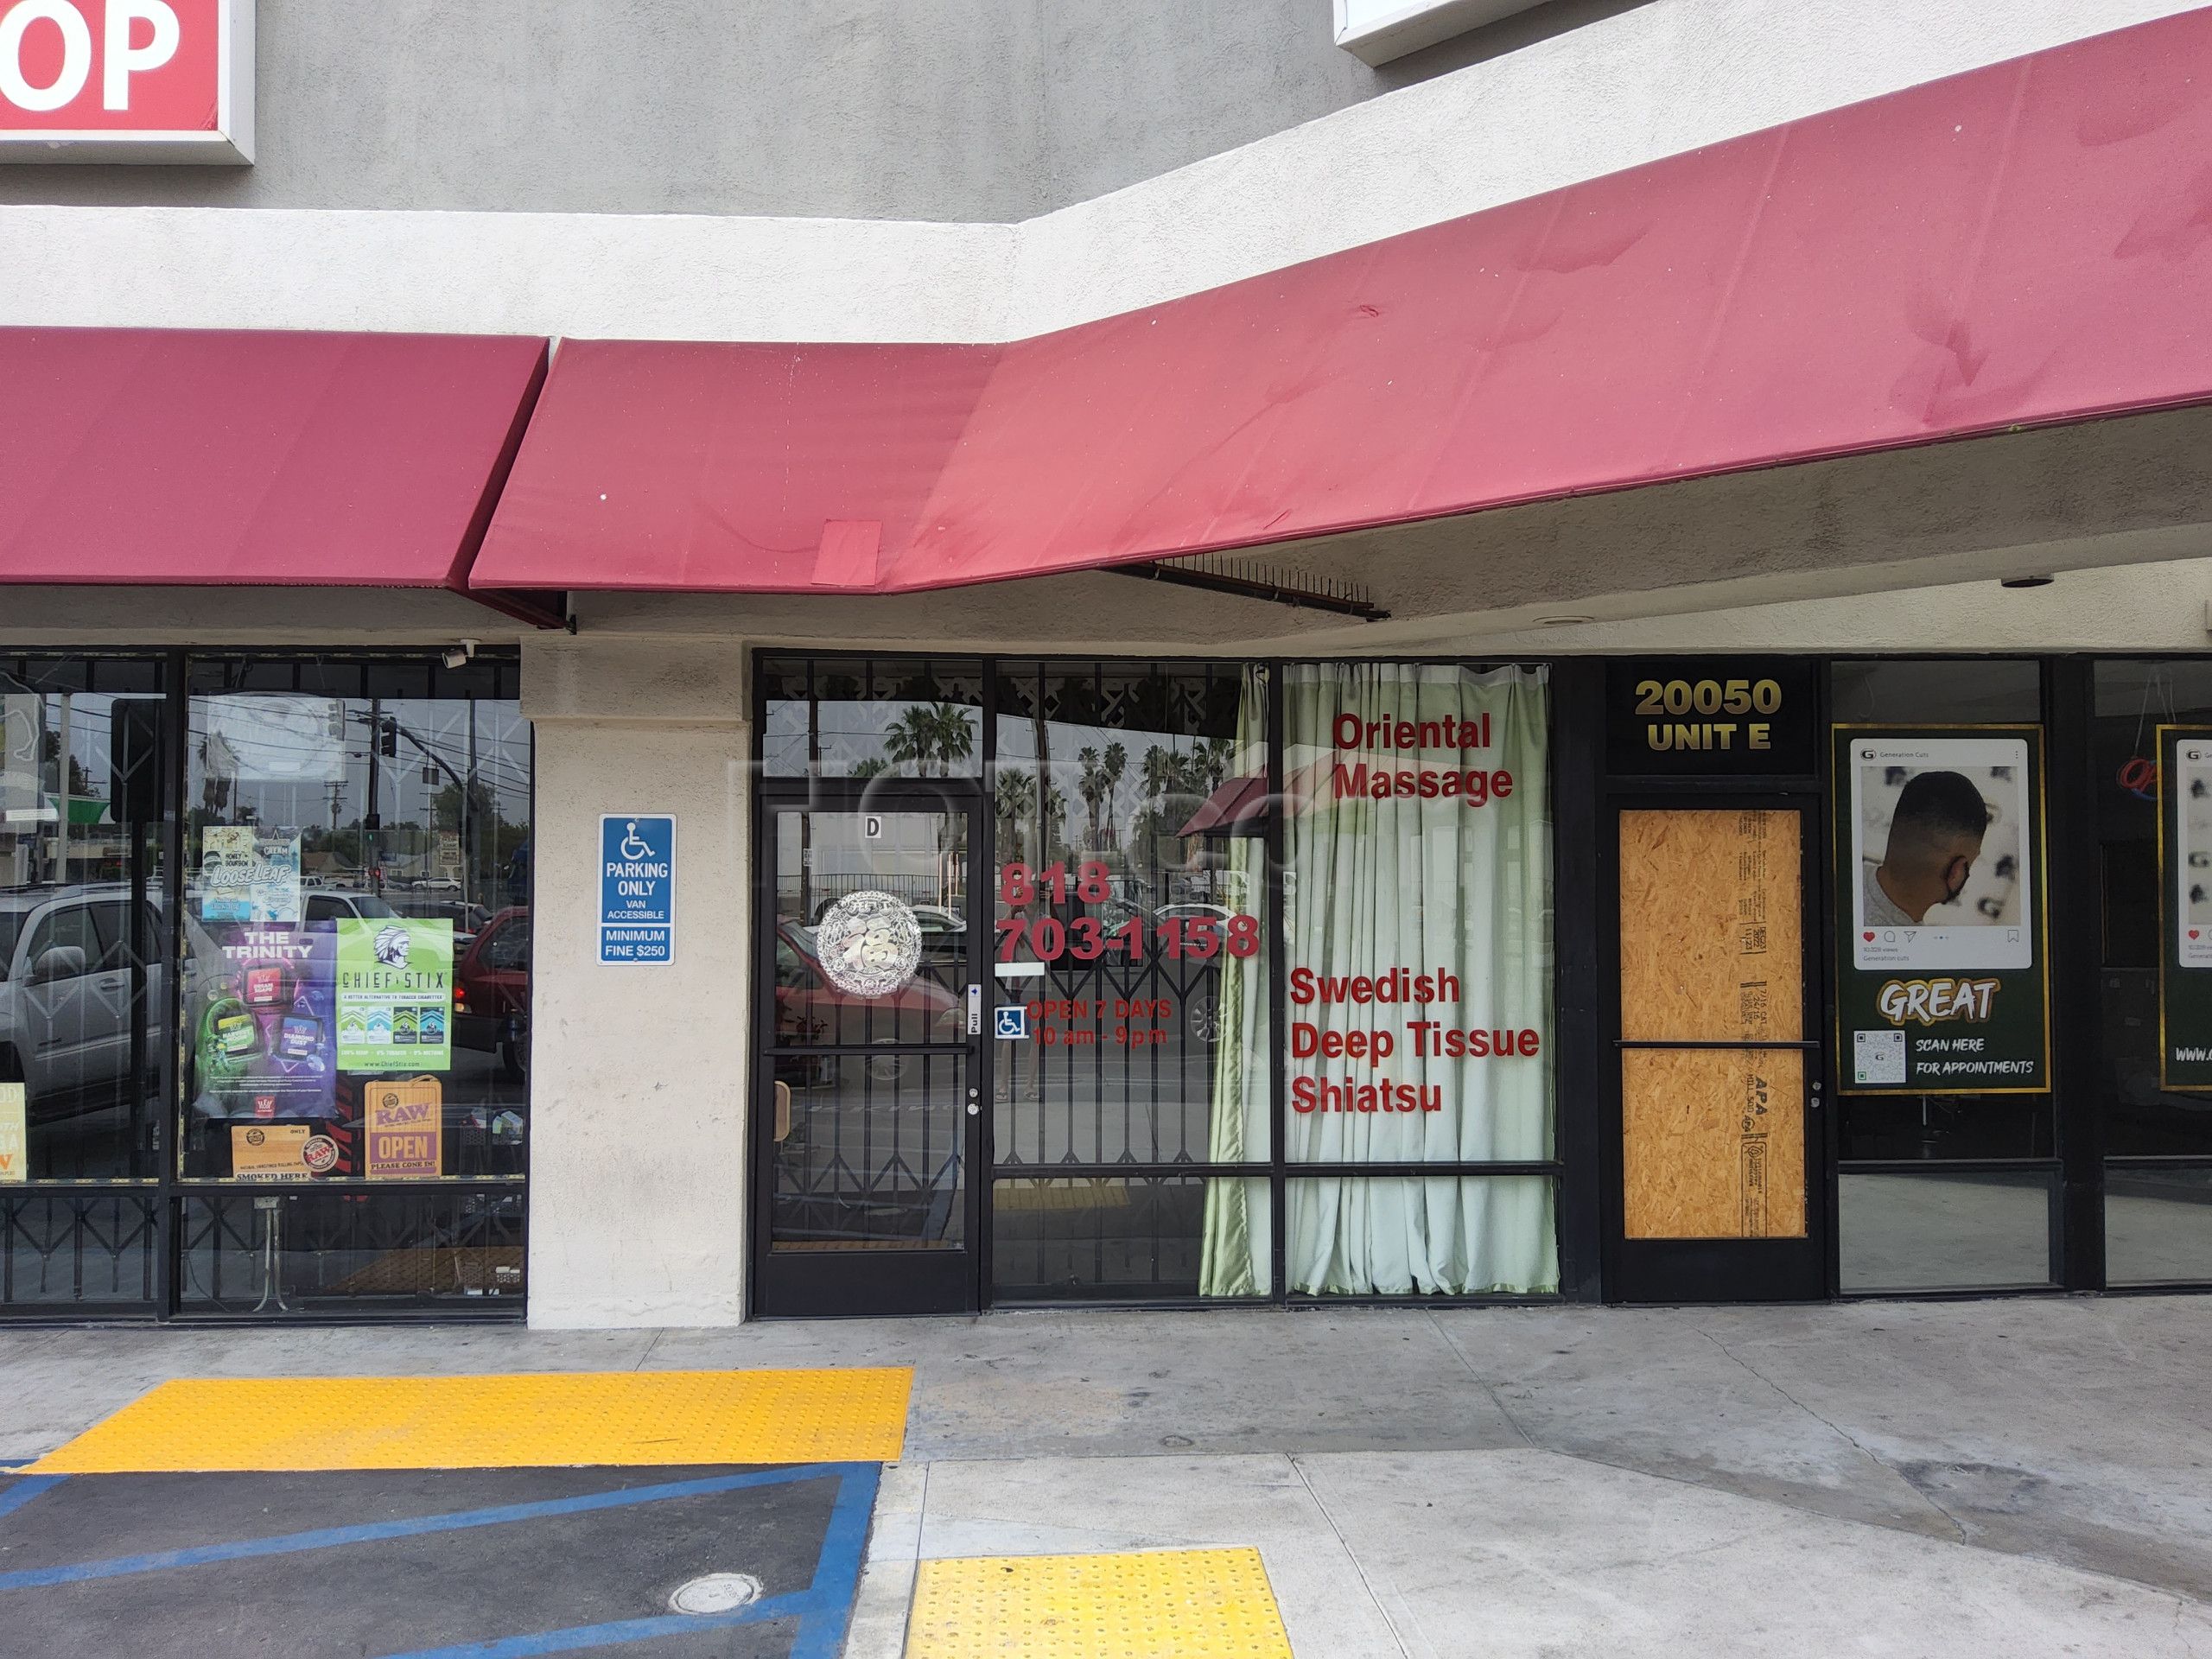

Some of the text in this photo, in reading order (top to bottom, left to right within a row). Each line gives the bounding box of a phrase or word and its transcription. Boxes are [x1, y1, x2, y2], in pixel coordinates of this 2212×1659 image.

[0, 0, 180, 111] OP
[1635, 679, 1782, 715] 20050
[1332, 712, 1490, 750] Oriental
[1648, 723, 1770, 751] UNIT E
[1334, 763, 1513, 807] Massage
[867, 817, 879, 836] D
[607, 862, 668, 878] PARKING
[618, 880, 656, 896] ONLY
[1001, 861, 1110, 906] 818
[607, 911, 664, 919] ACCESSIBLE
[245, 931, 289, 944] THE
[606, 930, 665, 941] MINIMUM
[996, 914, 1259, 963] 703-1158
[222, 946, 313, 958] TRINITY
[606, 944, 665, 957] FINE $250
[404, 972, 443, 988] STIX
[1290, 967, 1459, 1004] Swedish
[1027, 999, 1172, 1020] OPEN 7 DAYS
[1880, 982, 1996, 1021] GREAT
[1033, 1027, 1057, 1046] 10
[1063, 1031, 1095, 1046] am
[1292, 1021, 1539, 1067] Deep Tissue
[1916, 1038, 1985, 1052] SCAN HERE
[1916, 1061, 2033, 1076] FOR APPOINTMENTS
[1292, 1076, 1441, 1113] Shiatsu
[1756, 1076, 1768, 1116] APA
[375, 1103, 433, 1126] RAW
[378, 1136, 428, 1160] OPEN
